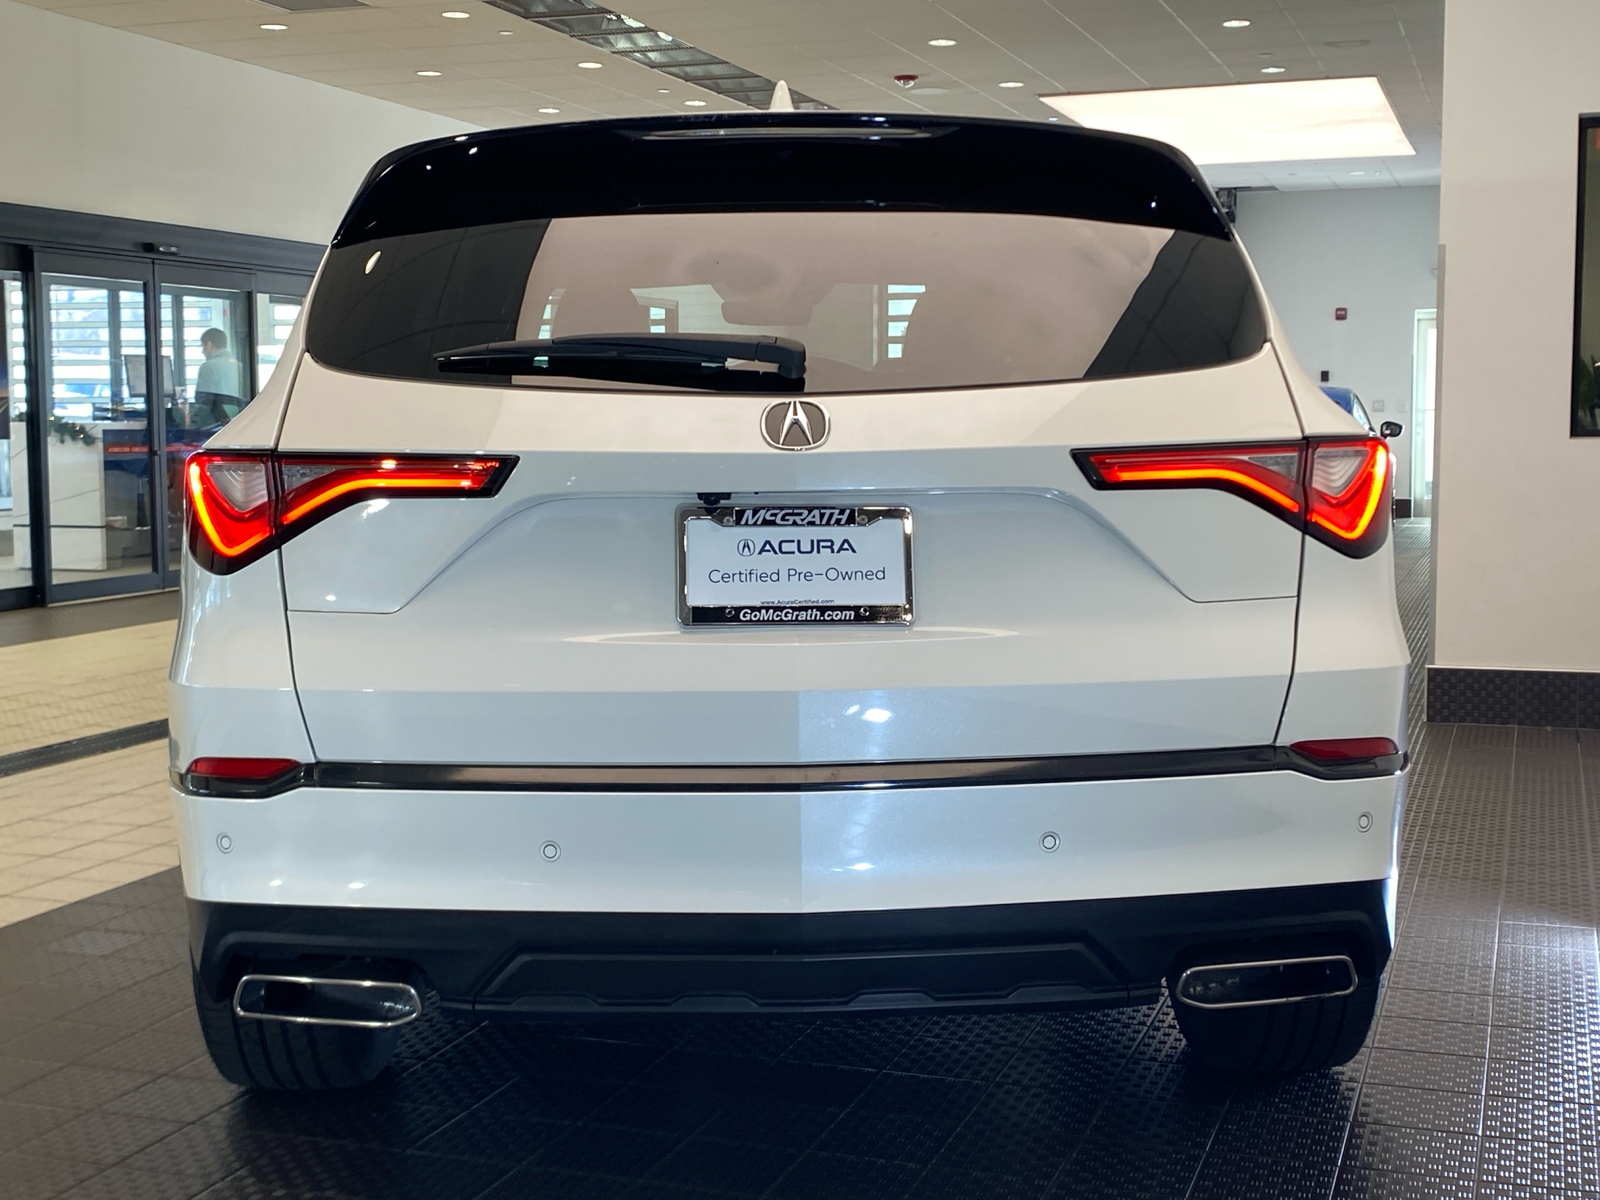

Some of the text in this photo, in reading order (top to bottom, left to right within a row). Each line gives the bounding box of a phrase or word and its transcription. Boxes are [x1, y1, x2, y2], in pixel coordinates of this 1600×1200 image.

[757, 538, 857, 555] ACURA
[708, 566, 886, 584] Certified Pre-Owned
[740, 608, 855, 621] GoMcGrath.com
